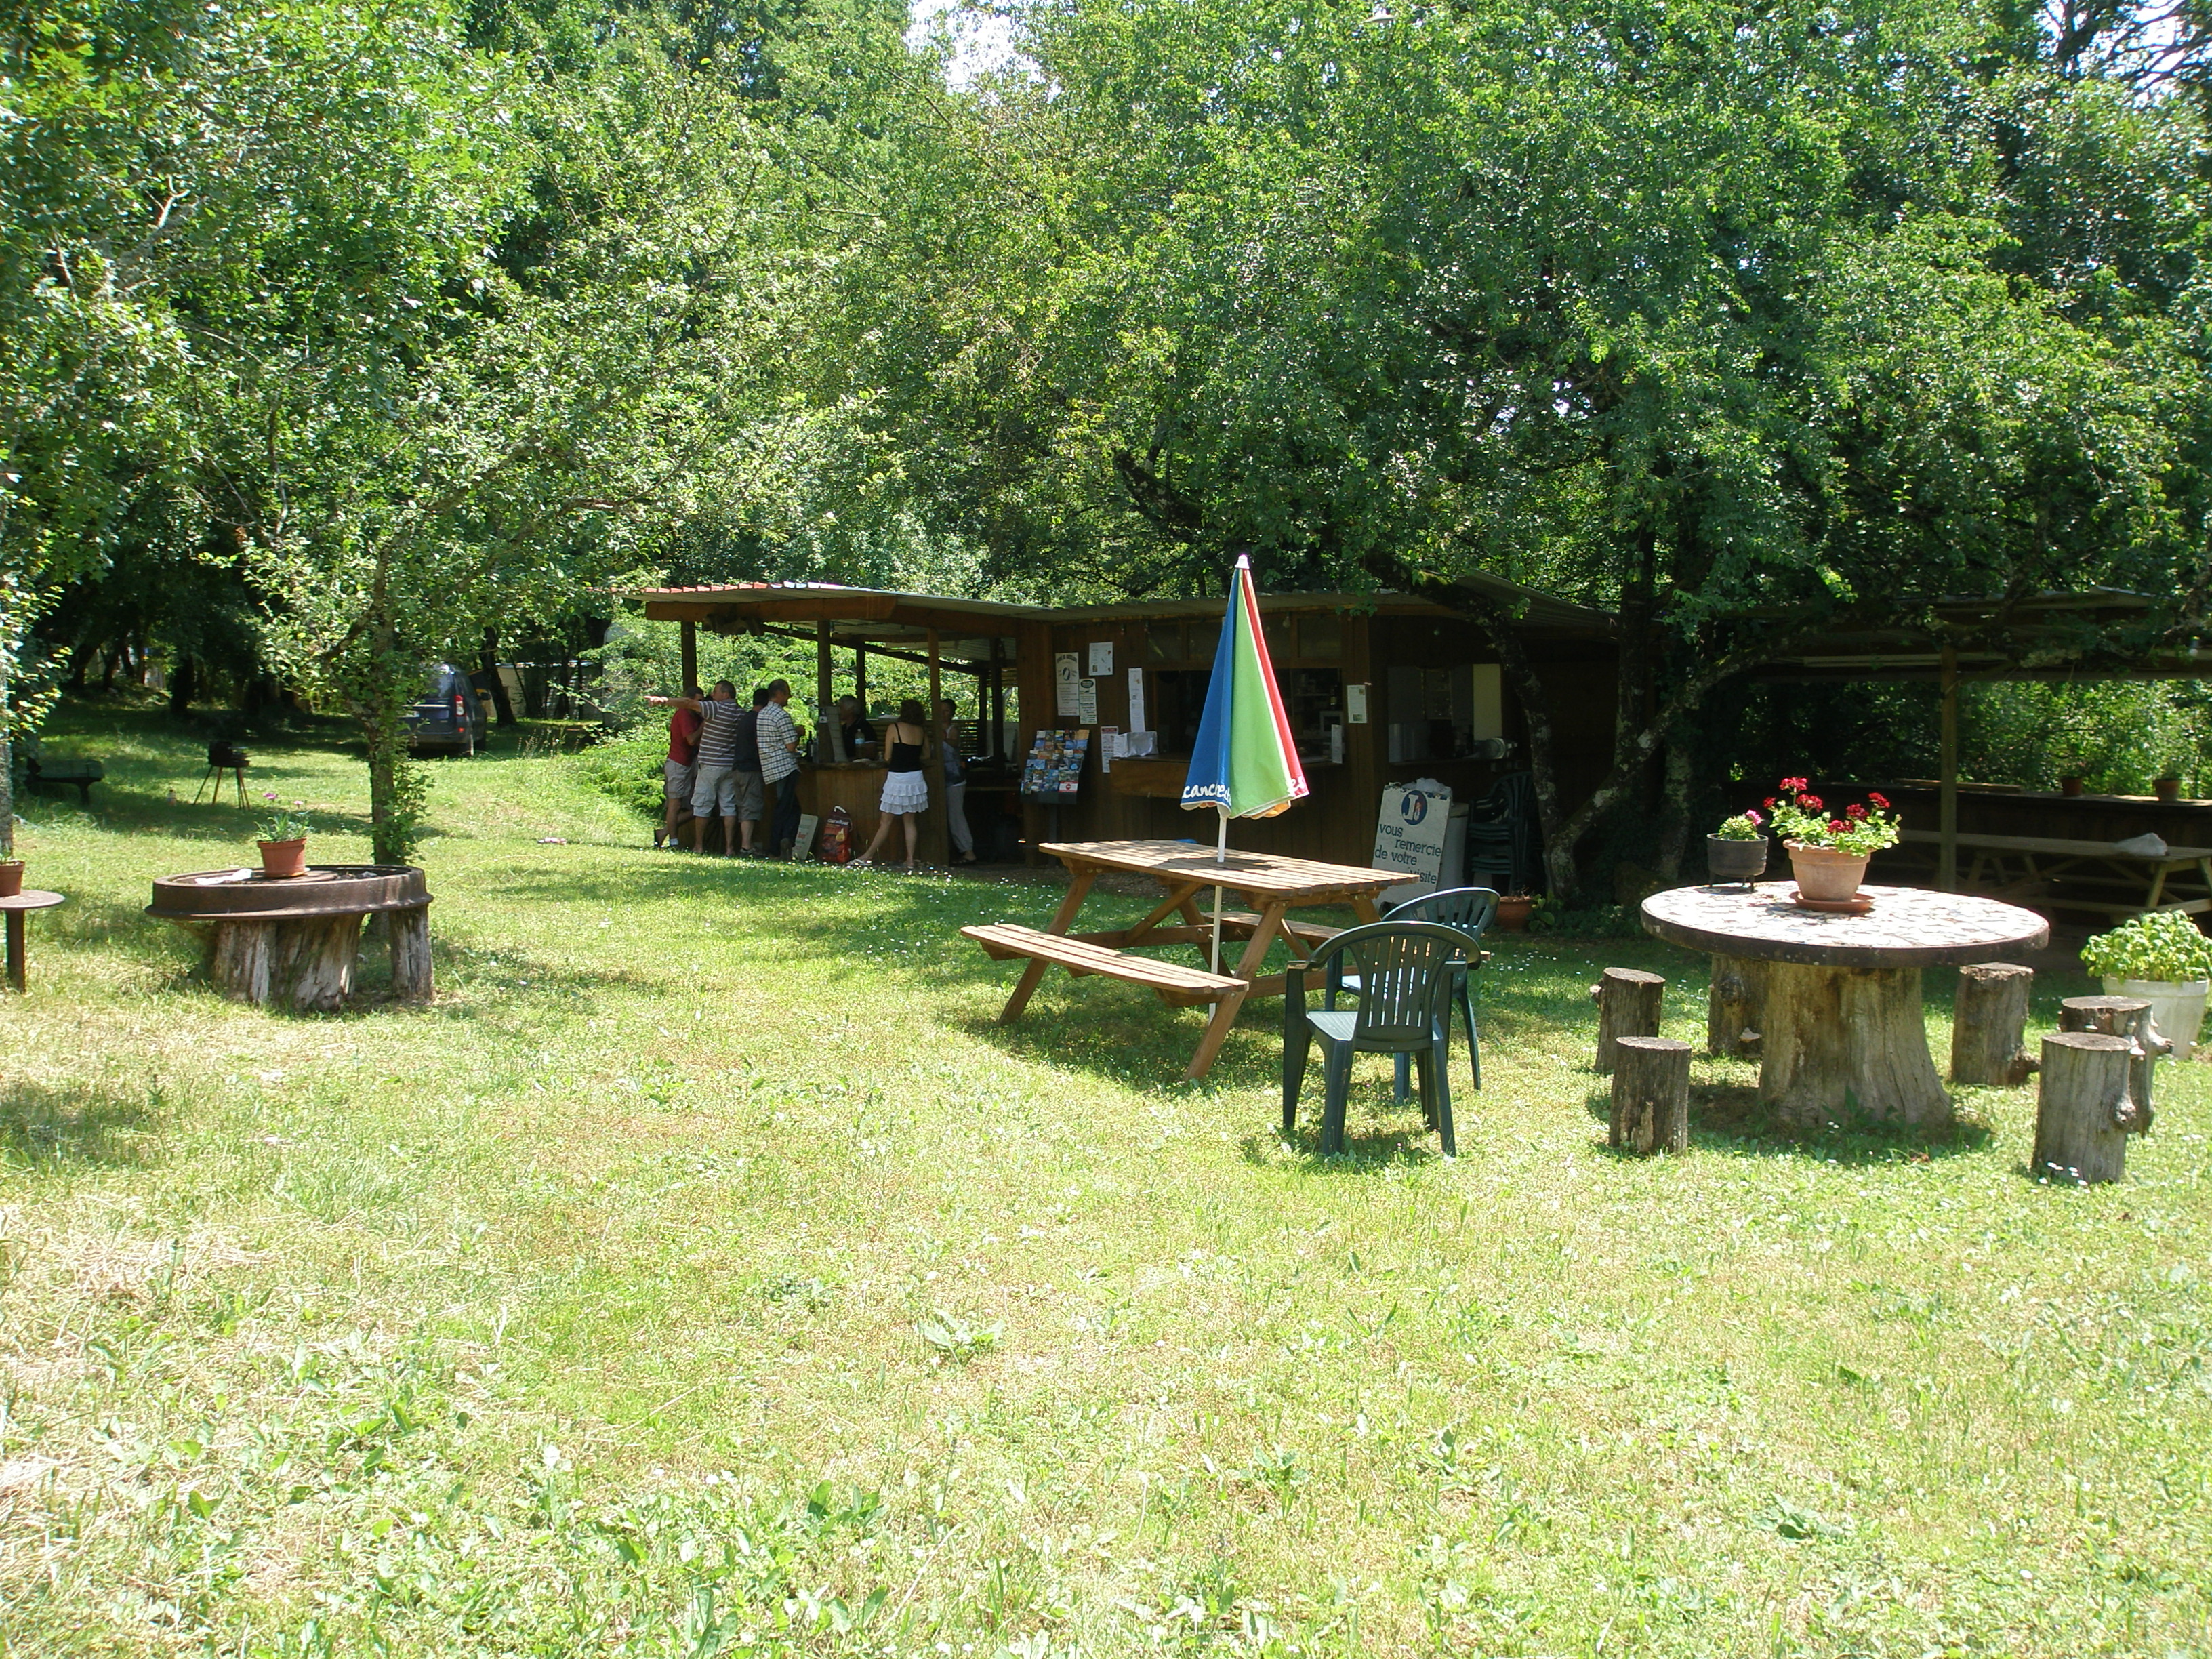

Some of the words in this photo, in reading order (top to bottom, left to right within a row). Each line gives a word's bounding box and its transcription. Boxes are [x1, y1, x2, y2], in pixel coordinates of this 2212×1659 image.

[1380, 824, 1404, 837] vous
[1374, 845, 1388, 859] de
[1391, 851, 1418, 865] votre
[1395, 838, 1441, 857] remercie
